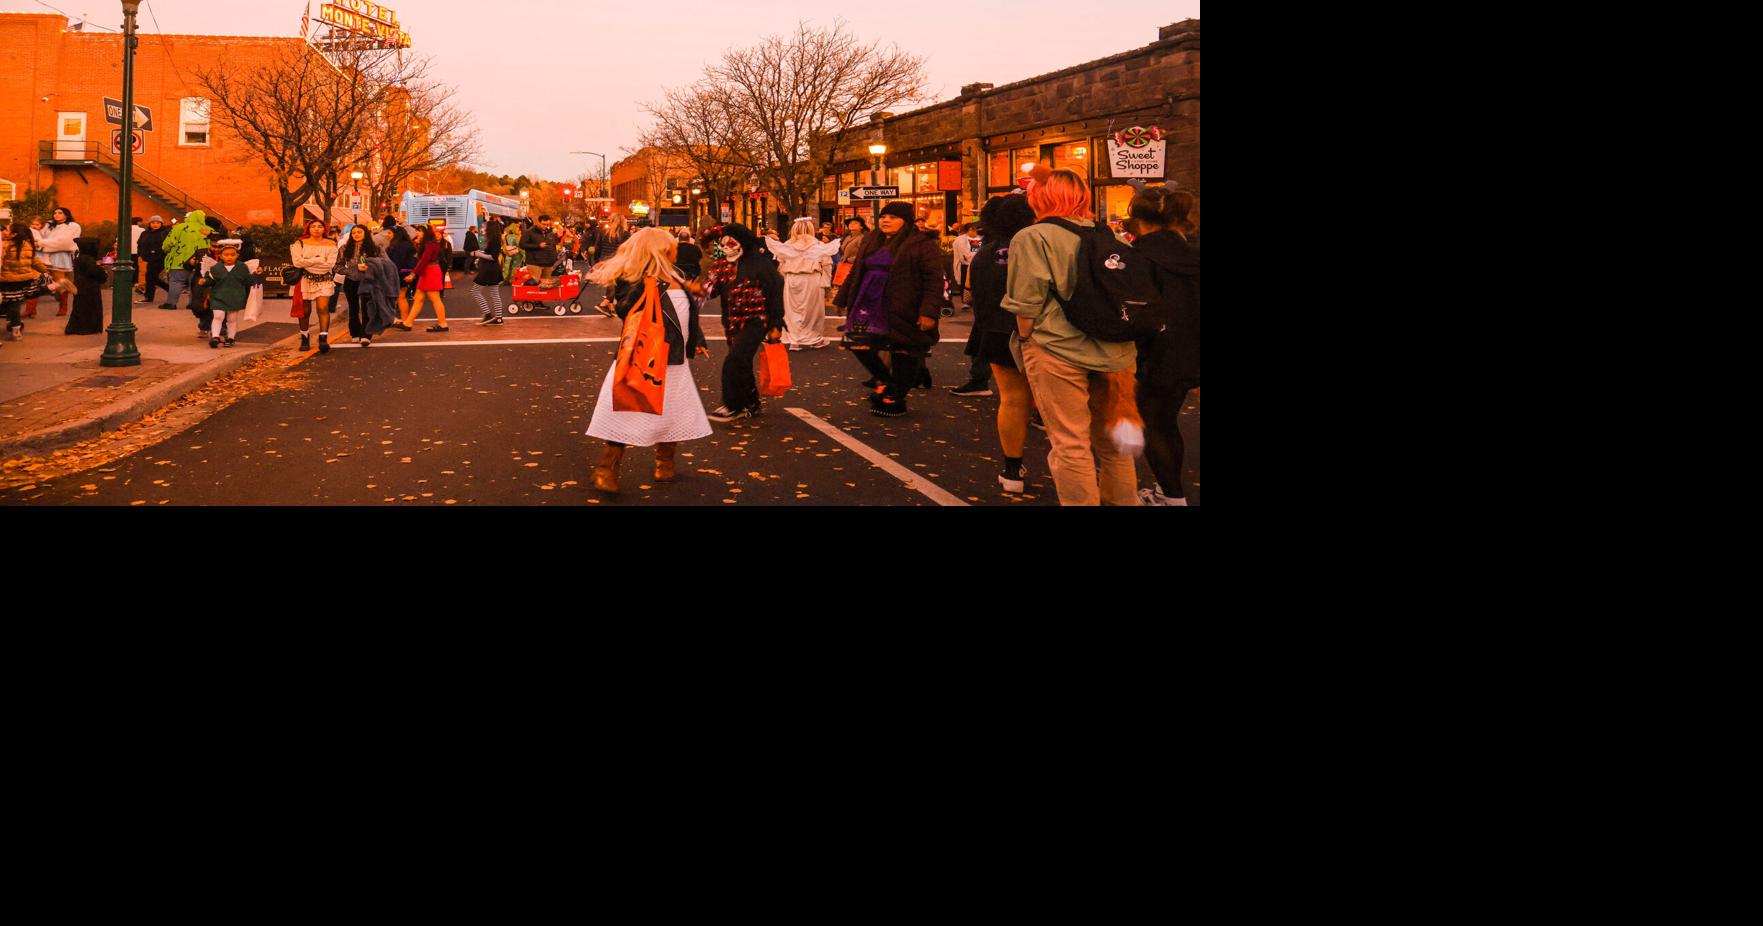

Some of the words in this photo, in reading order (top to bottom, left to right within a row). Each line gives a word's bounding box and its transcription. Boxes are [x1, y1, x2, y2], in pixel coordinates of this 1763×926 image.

[321, 4, 371, 34] MONTE
[108, 105, 122, 118] ONE
[1117, 148, 1156, 159] Sweet
[1116, 160, 1159, 174] Shoppe
